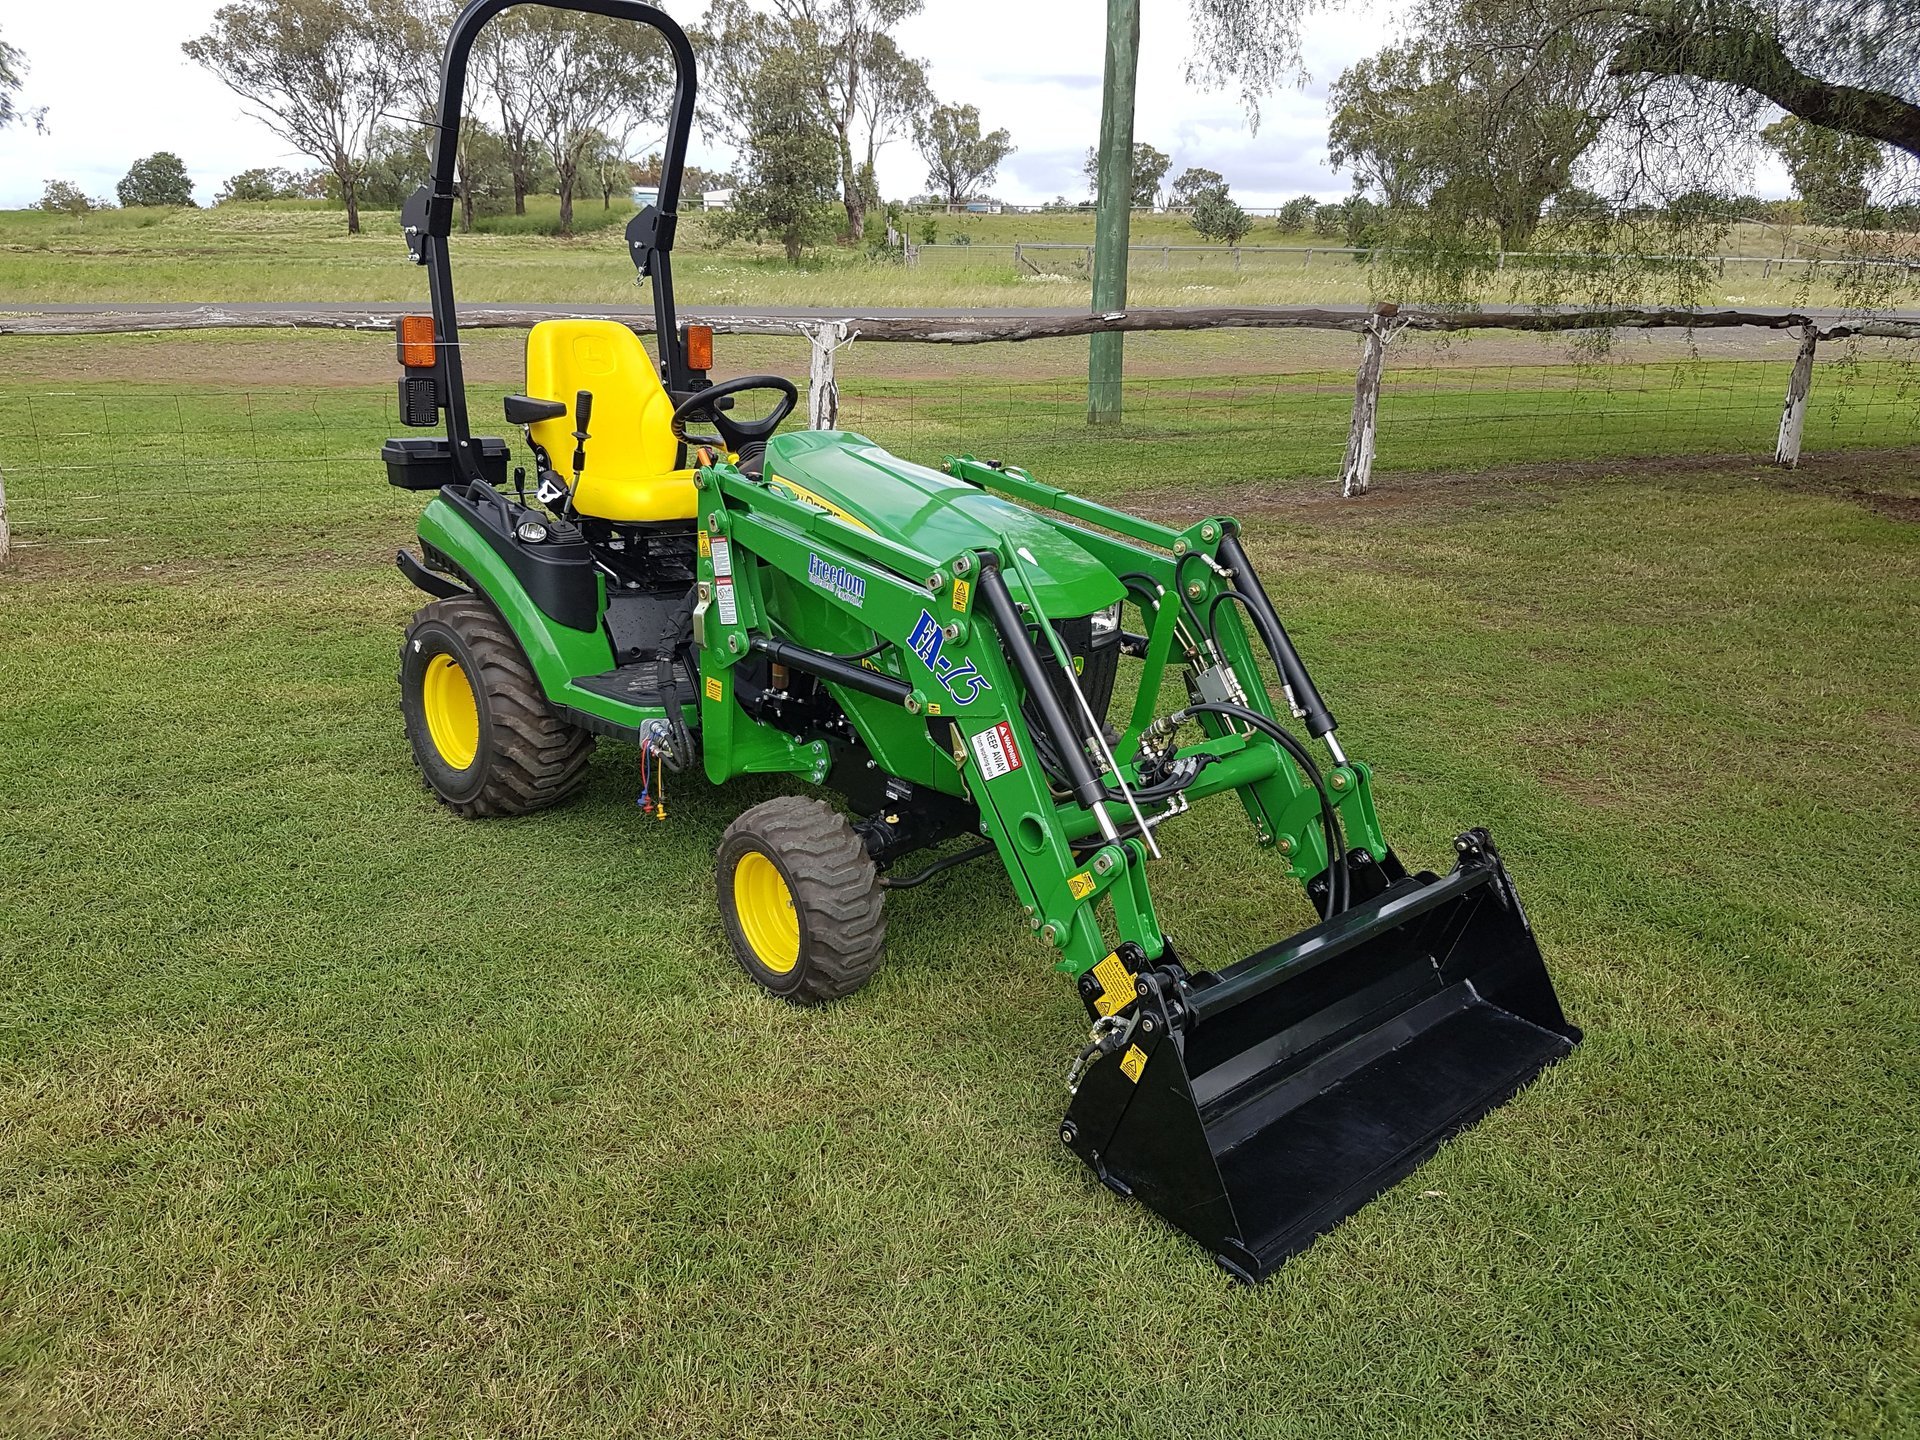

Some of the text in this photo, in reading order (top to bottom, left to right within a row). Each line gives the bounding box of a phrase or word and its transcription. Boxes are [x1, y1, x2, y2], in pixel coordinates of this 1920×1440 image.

[808, 552, 866, 599] Freedom
[906, 608, 992, 706] FA-15
[975, 735, 994, 778] from working area
[985, 729, 1007, 773] KEEP AWAY
[1003, 734, 1019, 768] WARNING
[1117, 966, 1134, 992] CAUTION
